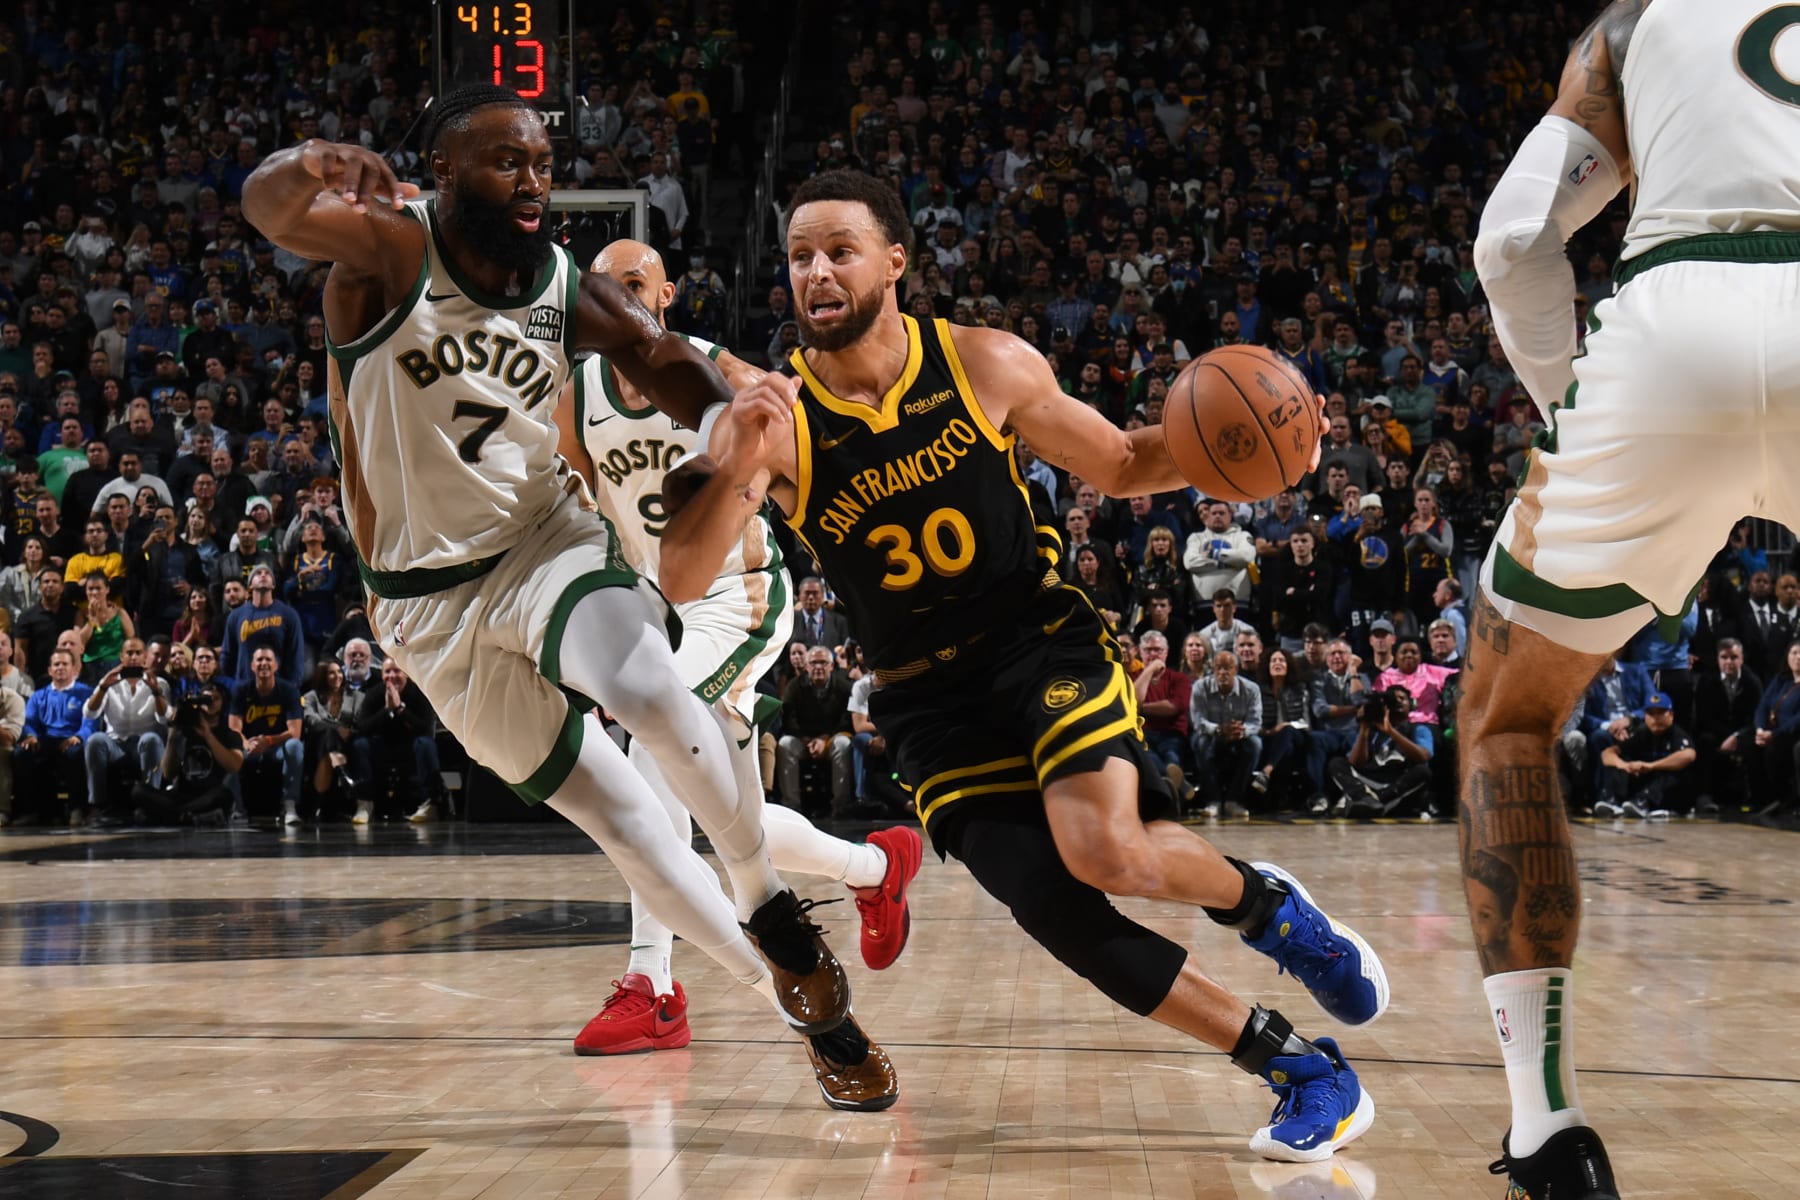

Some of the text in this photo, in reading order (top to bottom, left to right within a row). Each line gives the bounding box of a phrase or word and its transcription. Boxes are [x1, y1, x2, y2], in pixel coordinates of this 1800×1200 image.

[458, 3, 532, 35] 41.3
[493, 39, 545, 98] 13
[526, 325, 561, 340] PRINT
[531, 308, 561, 328] VISTA
[396, 330, 554, 411] BOSTON
[903, 389, 955, 416] Rakuten
[452, 400, 509, 464] 7
[598, 438, 687, 488] BOSTO
[819, 418, 977, 545] SAN FRANCISCO
[864, 507, 976, 591] 30
[703, 661, 738, 698] CELTICS
